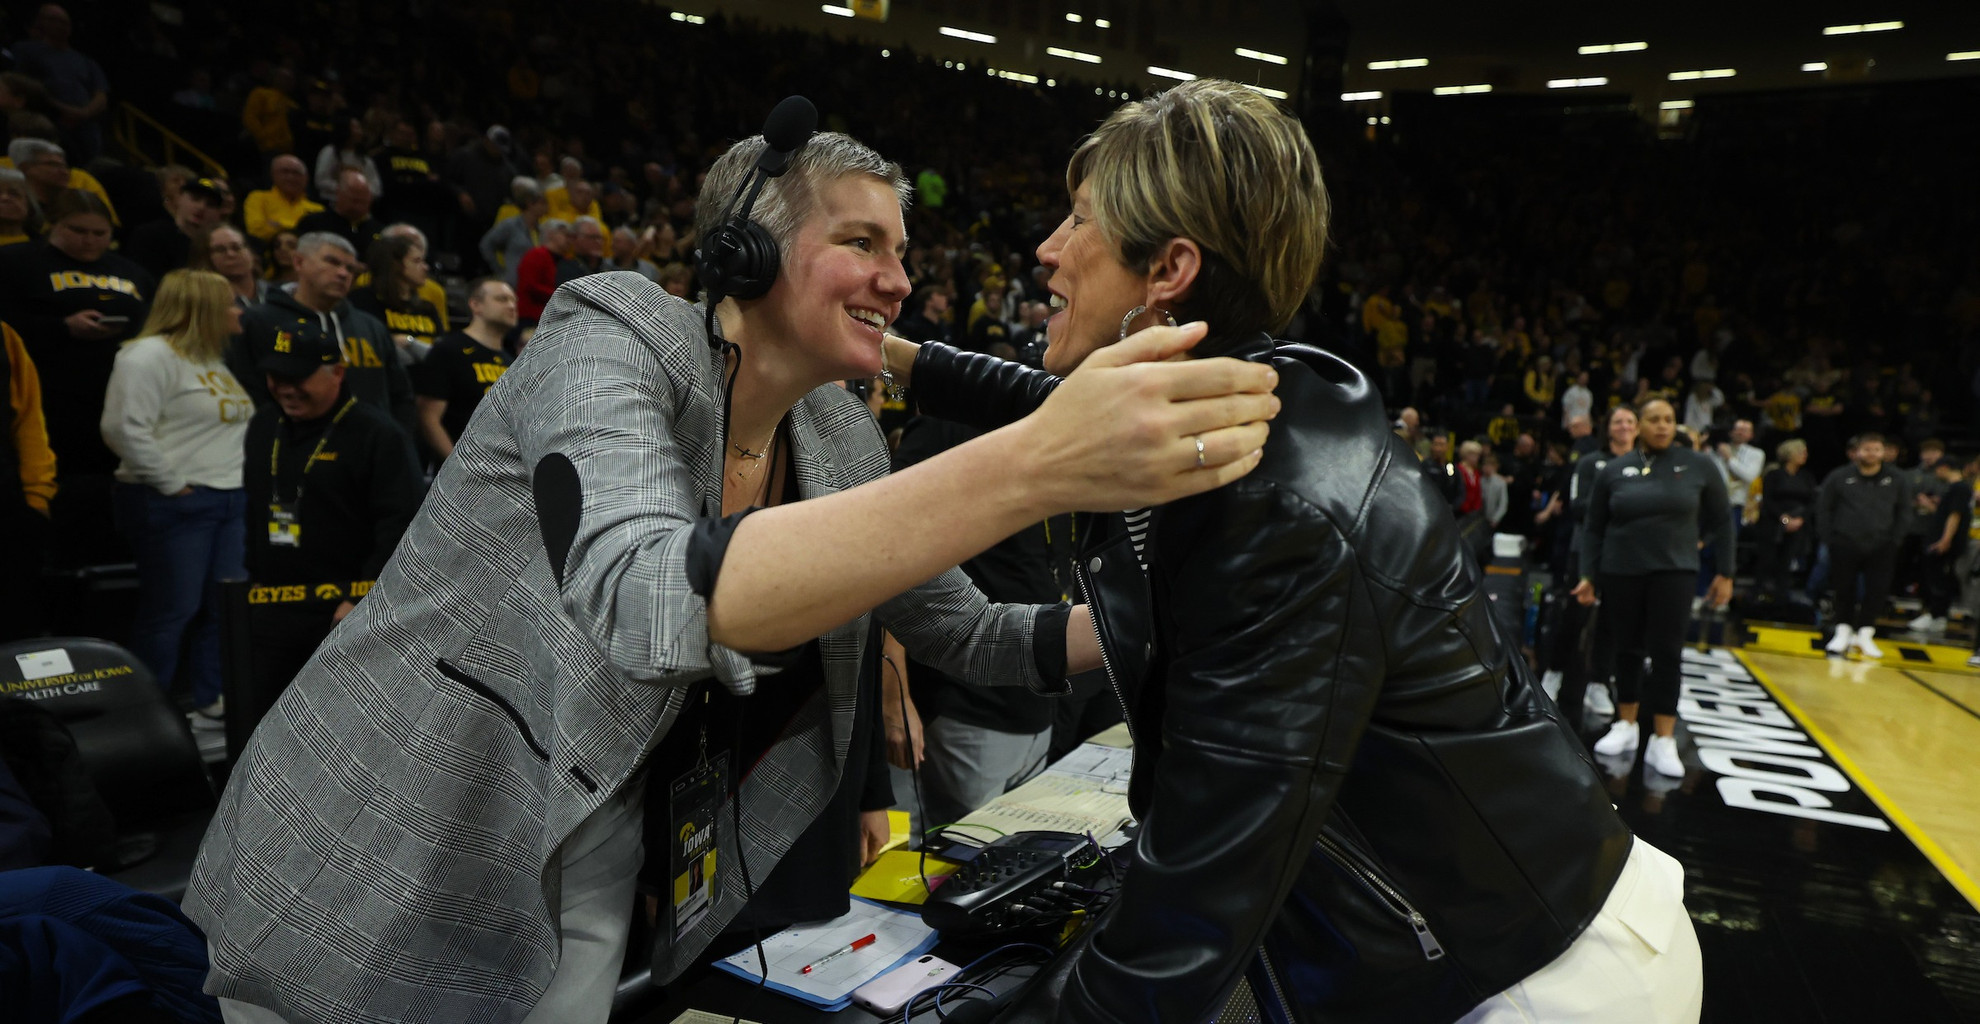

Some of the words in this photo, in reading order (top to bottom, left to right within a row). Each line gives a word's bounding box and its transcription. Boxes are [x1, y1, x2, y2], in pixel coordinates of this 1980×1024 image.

[50, 270, 143, 302] IOWA
[0, 673, 78, 693] UNIVERSITY
[94, 664, 133, 679] IOWA
[63, 681, 102, 695] CARE
[682, 823, 711, 858] IOWA
